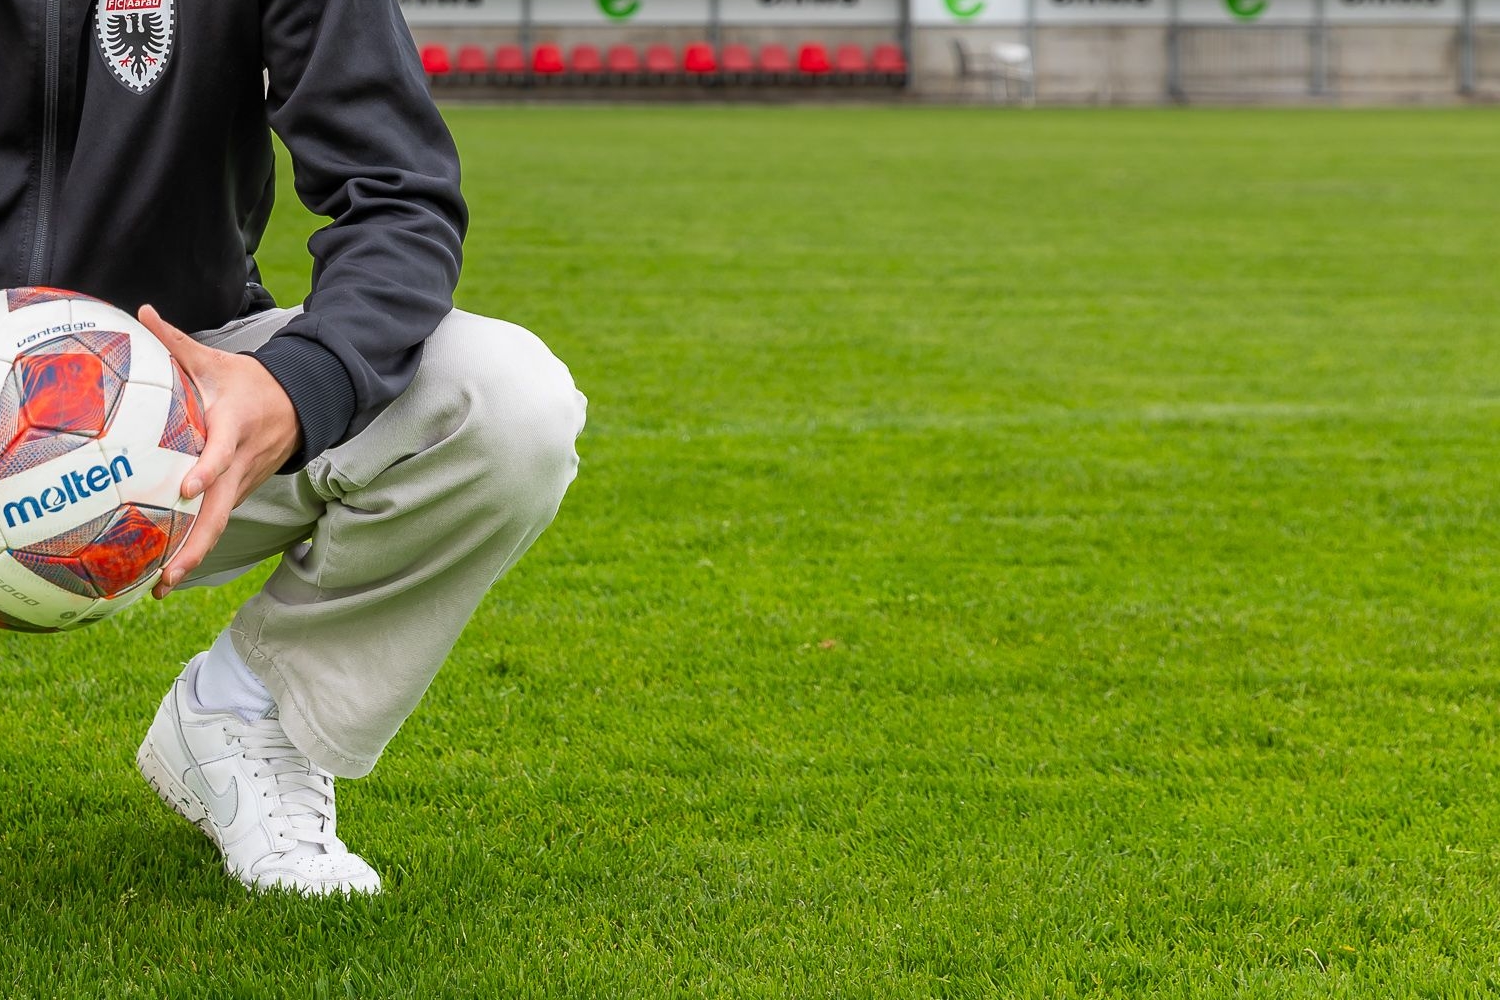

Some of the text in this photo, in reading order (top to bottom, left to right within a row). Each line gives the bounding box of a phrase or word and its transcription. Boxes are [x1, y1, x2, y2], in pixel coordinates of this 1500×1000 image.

[108, 0, 124, 9] FC
[17, 321, 96, 348] vantaggio
[3, 455, 133, 528] molten
